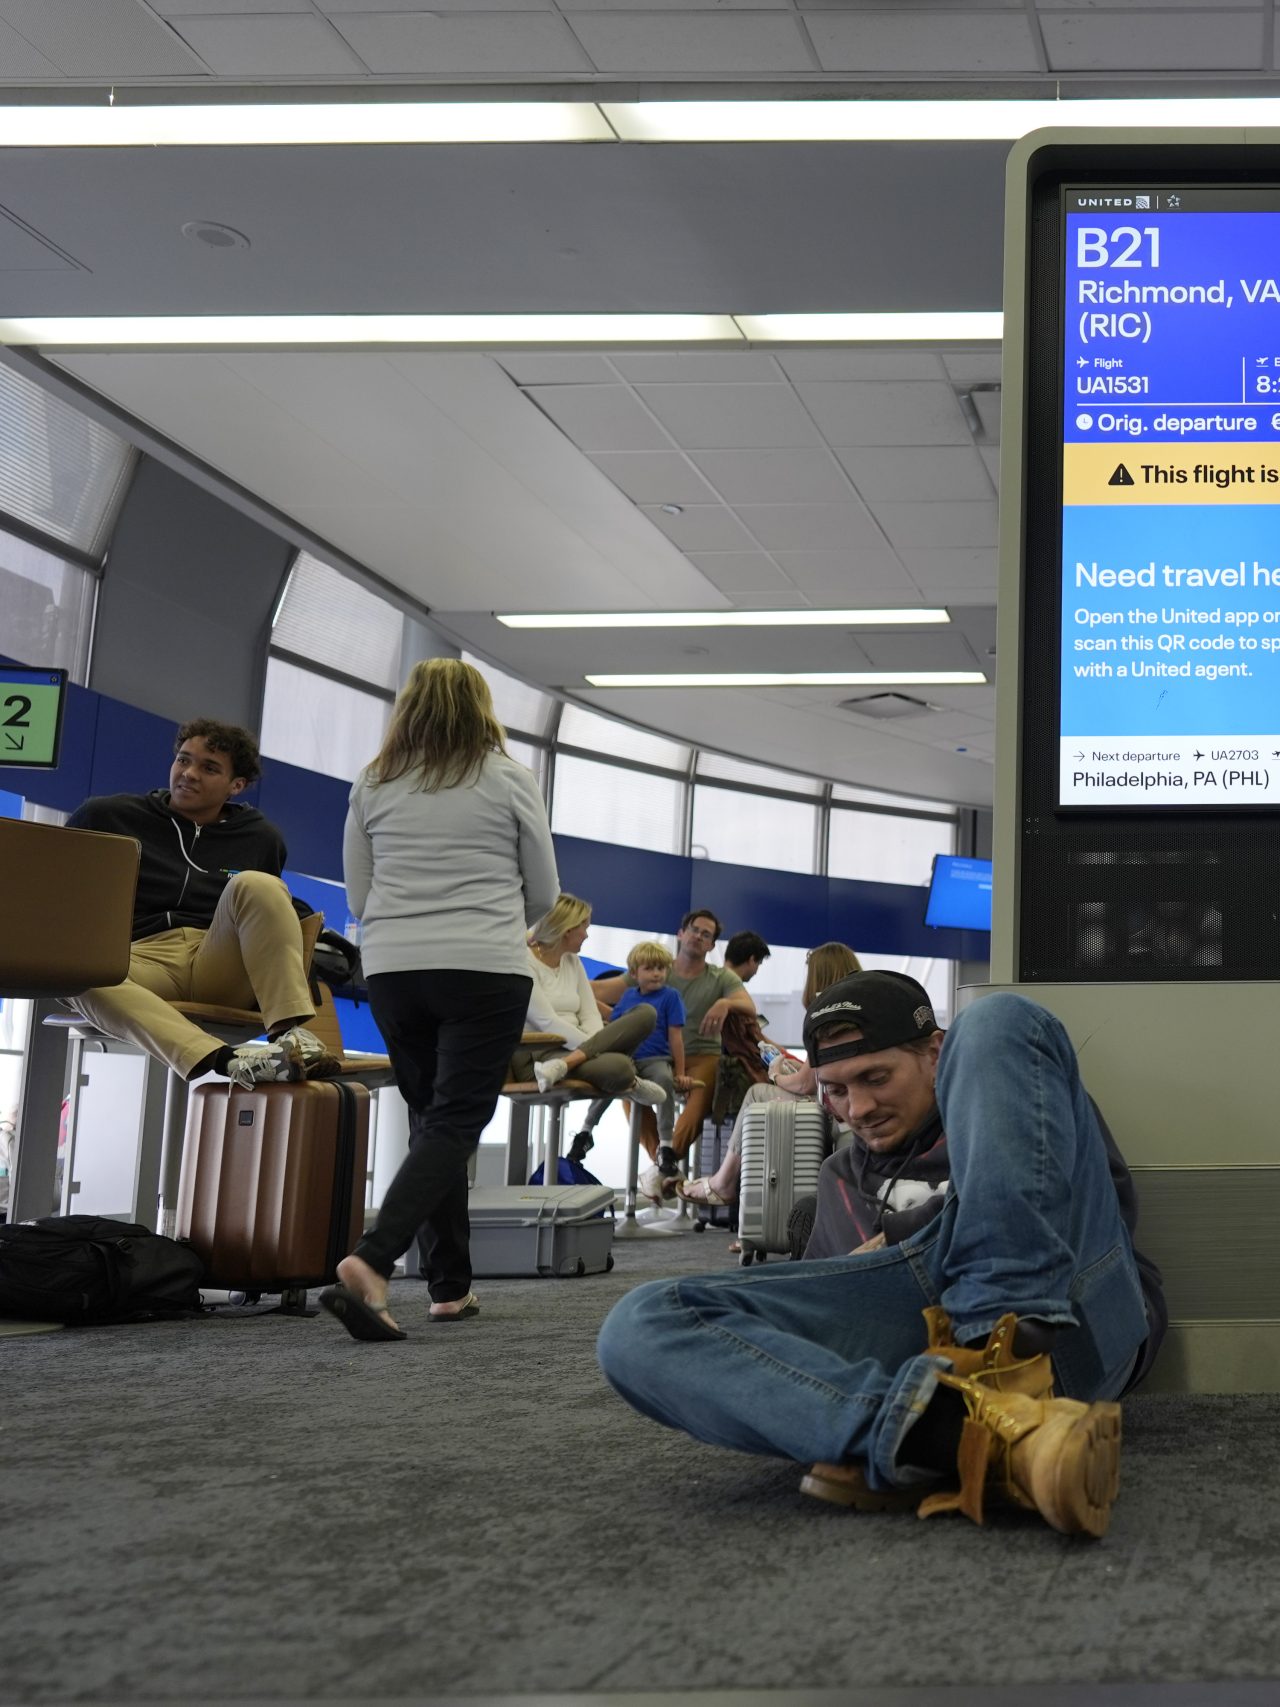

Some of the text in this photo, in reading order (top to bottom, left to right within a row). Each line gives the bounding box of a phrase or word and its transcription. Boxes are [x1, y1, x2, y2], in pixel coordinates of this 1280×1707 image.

[1077, 198, 1133, 207] UNITED
[1076, 226, 1160, 268] B21
[1078, 279, 1233, 309] Richmond,
[1079, 311, 1152, 344] (RIC)
[1093, 357, 1123, 370] Flight
[1076, 375, 1149, 395] UA1531
[1097, 413, 1149, 436] Orig.
[1153, 413, 1258, 435] departure
[1140, 464, 1188, 484] This
[1192, 464, 1256, 489] flight
[1260, 464, 1280, 483] is
[1075, 561, 1156, 588] Need
[1161, 561, 1246, 587] travel
[1074, 607, 1124, 628] Open
[1127, 607, 1159, 624] the
[1161, 607, 1221, 624] United
[1224, 611, 1260, 628] app
[1073, 638, 1117, 652] scan
[1120, 634, 1154, 651] this
[1157, 633, 1186, 653] QR
[1188, 634, 1235, 651] code
[1238, 635, 1258, 650] to
[1073, 660, 1253, 681] with a United agent.
[2, 694, 32, 728] 2
[1092, 751, 1120, 762] Next
[1122, 751, 1181, 764] departure
[1211, 749, 1259, 761] UA2703
[1073, 769, 1270, 791] Philadelphia, PA (PHL)
